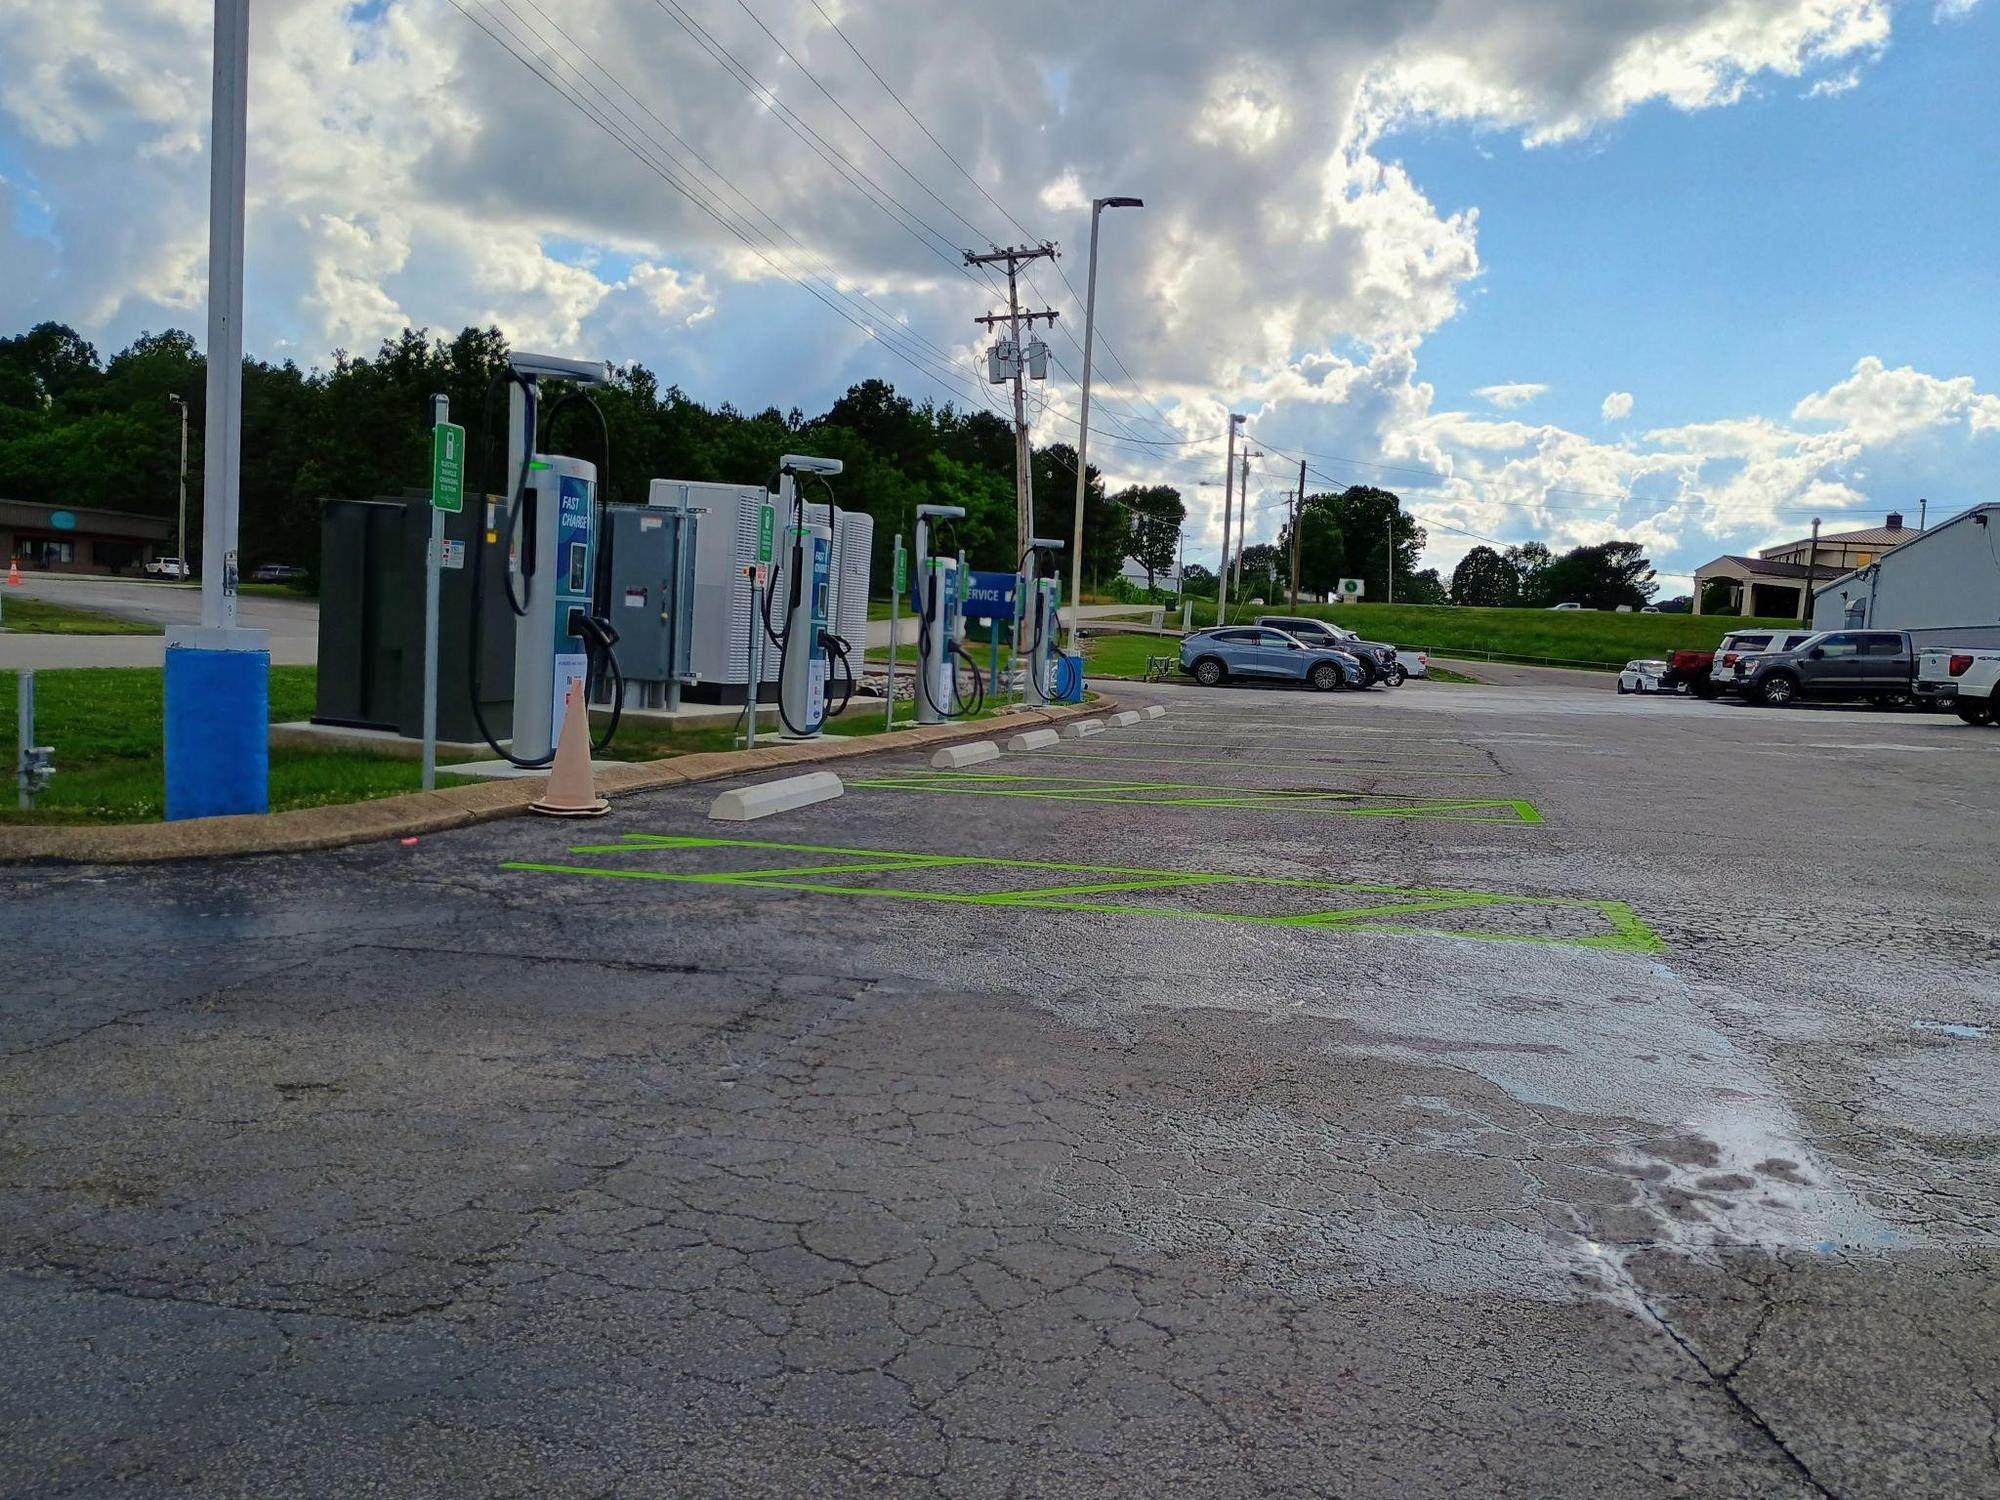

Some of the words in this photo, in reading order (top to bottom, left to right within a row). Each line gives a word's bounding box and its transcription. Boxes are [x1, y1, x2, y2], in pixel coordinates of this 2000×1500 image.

[562, 496, 580, 511] FAST
[562, 513, 588, 529] CHARGE
[968, 588, 999, 602] ERVICE
